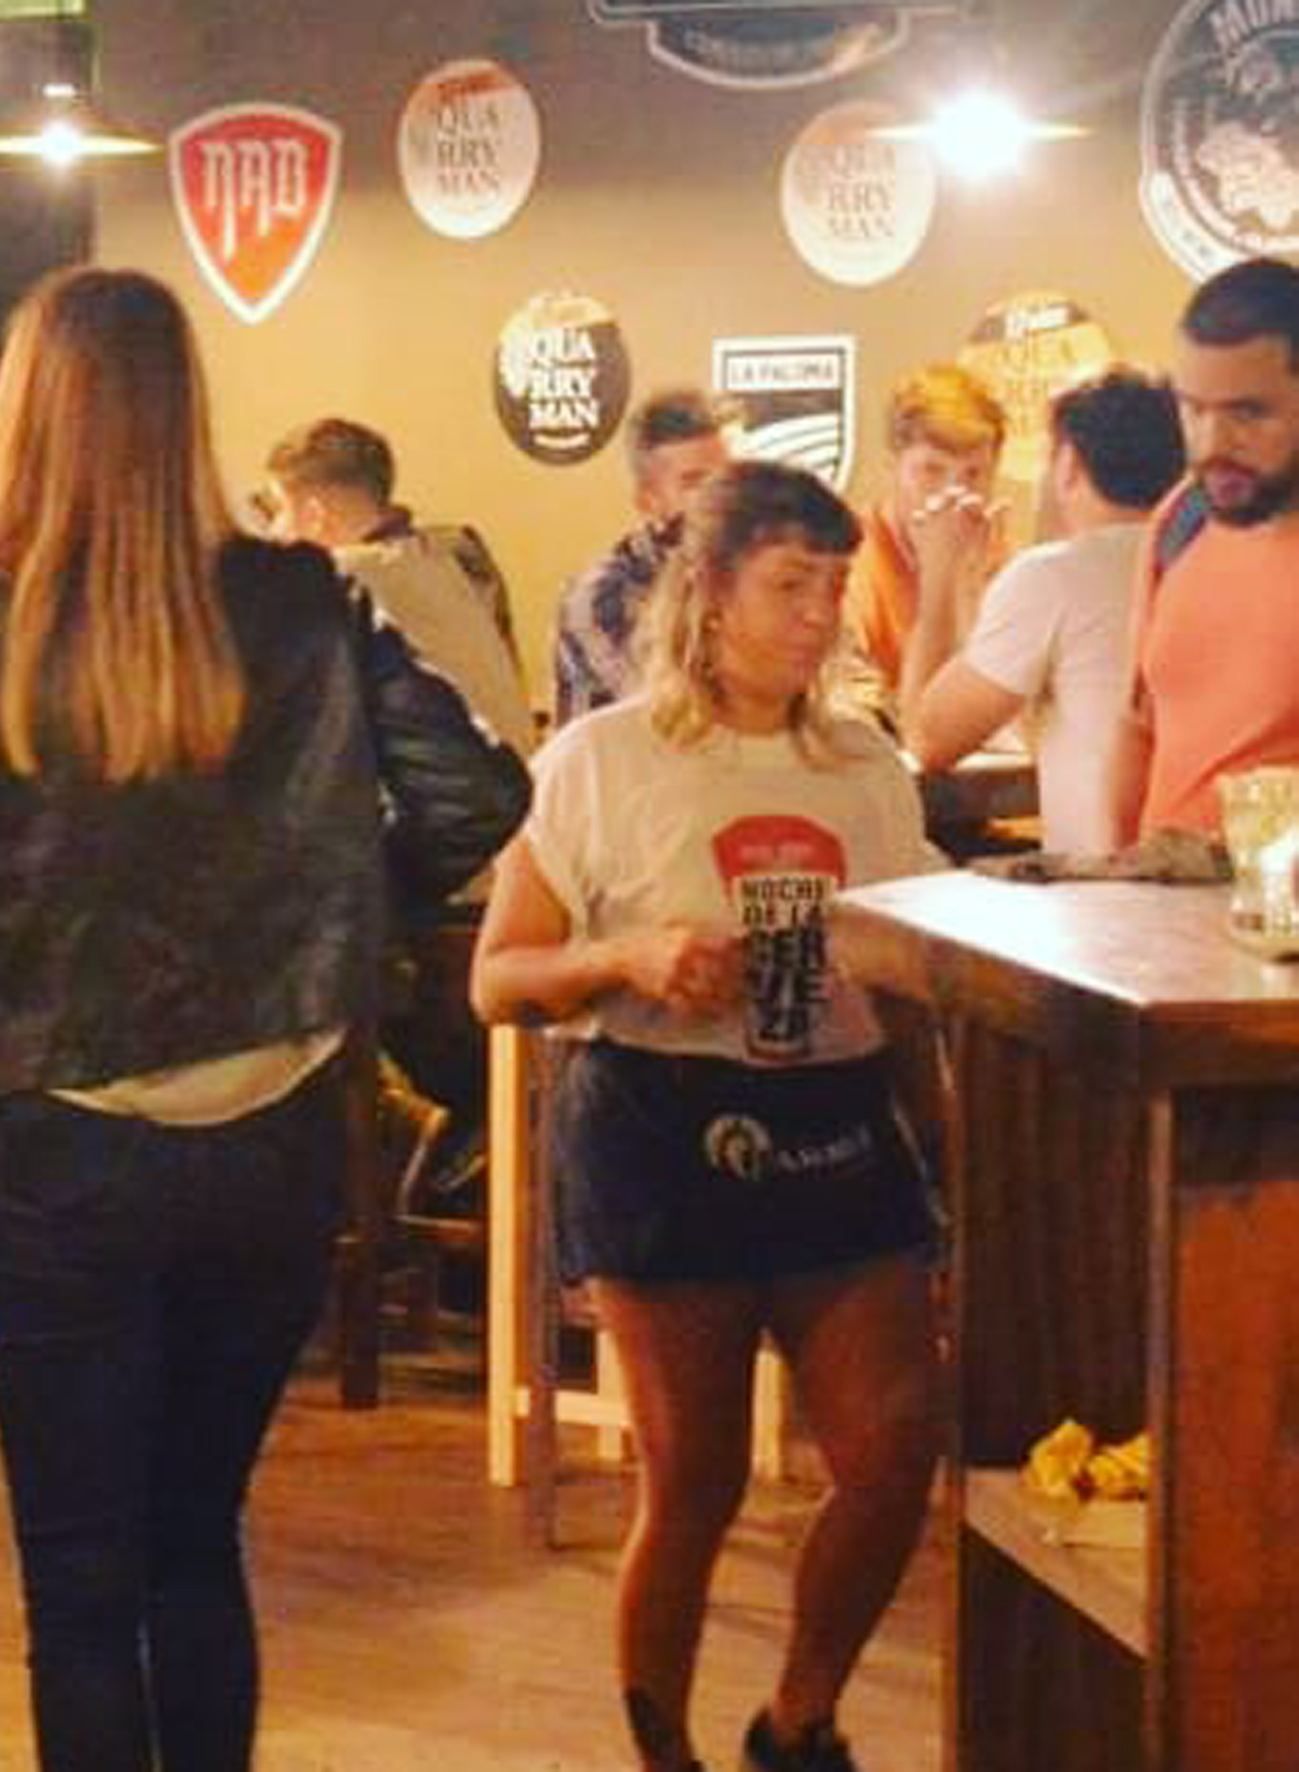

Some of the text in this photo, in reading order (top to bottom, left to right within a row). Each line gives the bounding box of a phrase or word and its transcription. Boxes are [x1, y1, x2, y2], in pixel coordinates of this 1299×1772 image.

[529, 326, 596, 369] QUA
[530, 366, 596, 399] RRY
[529, 398, 600, 428] MAN
[741, 877, 826, 901] NOCHE
